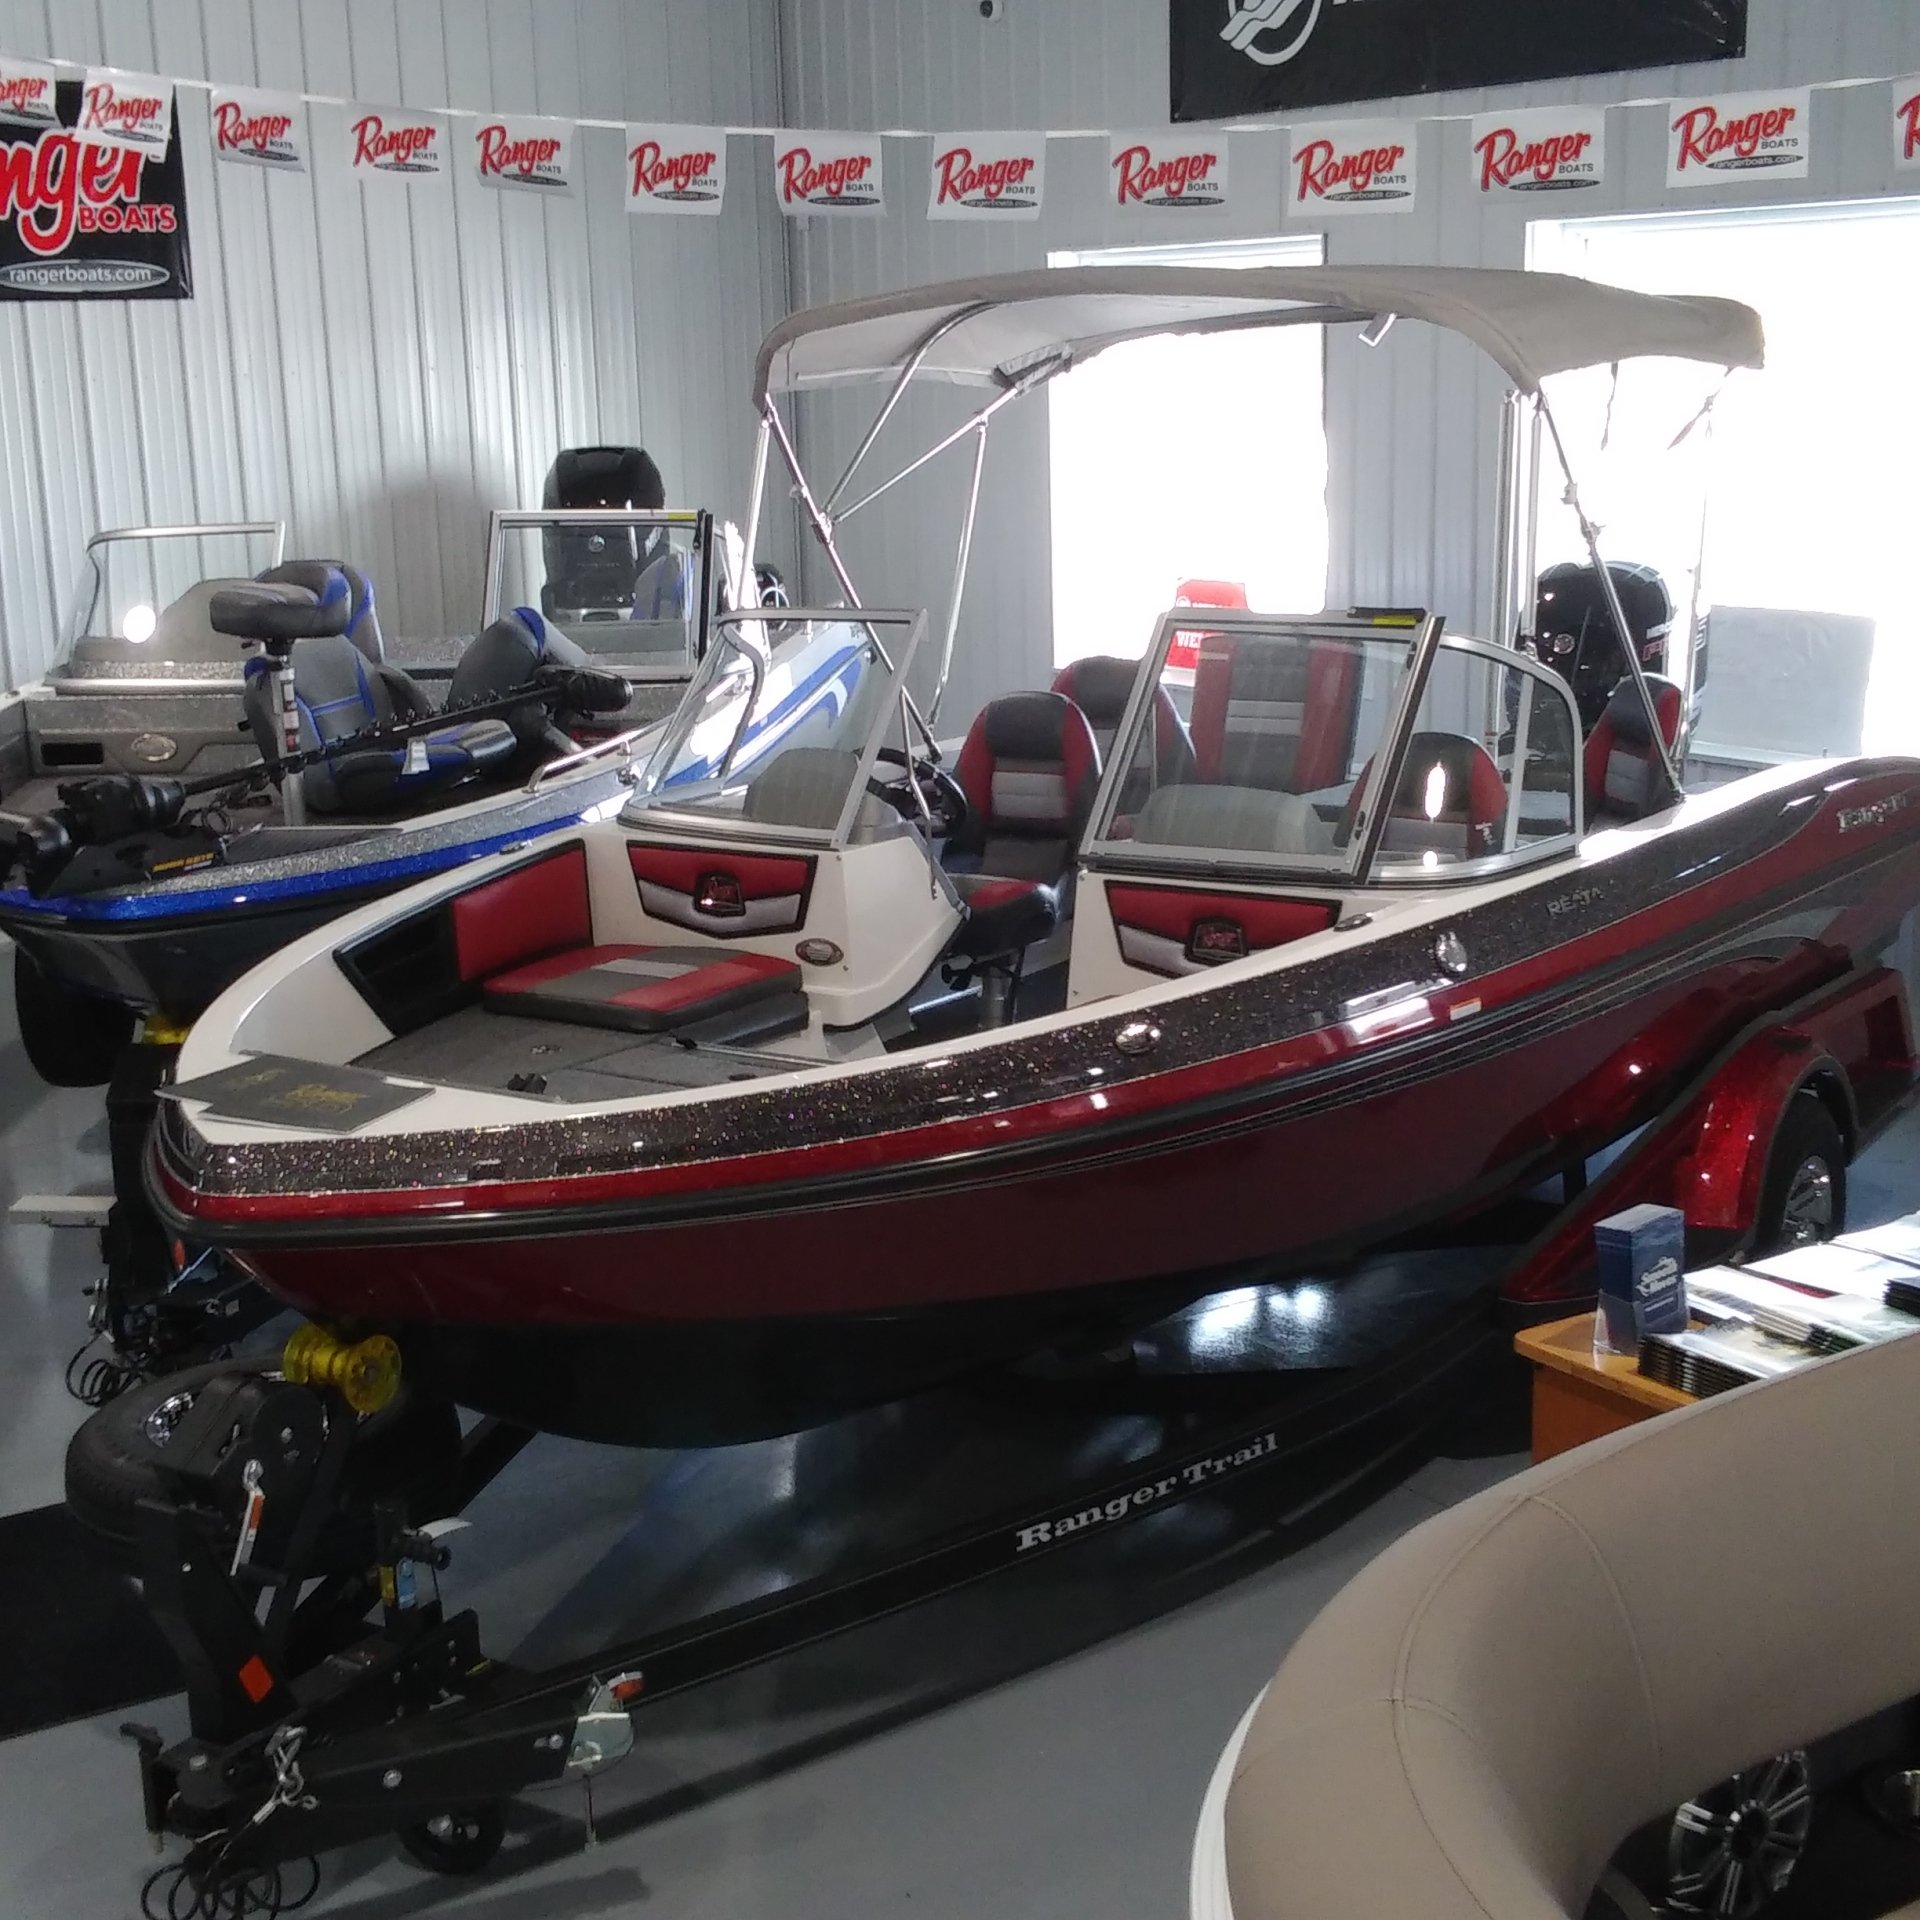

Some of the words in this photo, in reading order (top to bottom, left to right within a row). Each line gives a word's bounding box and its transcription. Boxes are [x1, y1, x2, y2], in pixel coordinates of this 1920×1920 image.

[84, 83, 162, 130] Ranger
[213, 101, 291, 150] Ranger
[350, 115, 436, 167] Ranger
[475, 125, 561, 176] Ranger
[1473, 128, 1592, 192] Ranger
[1671, 106, 1796, 171] Ranger
[1713, 155, 1798, 169] rangerboats.com
[1760, 138, 1799, 149] BOATS
[536, 165, 562, 174] BOATS
[628, 141, 716, 197] Ranger
[692, 177, 718, 187] BOATS
[777, 147, 871, 204] Ranger
[845, 183, 874, 192] BOATS
[935, 148, 1034, 206] Ranger
[1005, 186, 1035, 195] BOATS
[1112, 145, 1217, 205] Ranger
[1187, 182, 1219, 192] BOATS
[1292, 140, 1405, 202] Ranger
[1373, 175, 1407, 185] BOATS
[1558, 163, 1594, 174] BOATS
[78, 204, 177, 233] BOATS
[9, 263, 151, 283] rangerboats.com
[1016, 1476, 1177, 1552] Ranger
[1183, 1433, 1278, 1484] Trail
